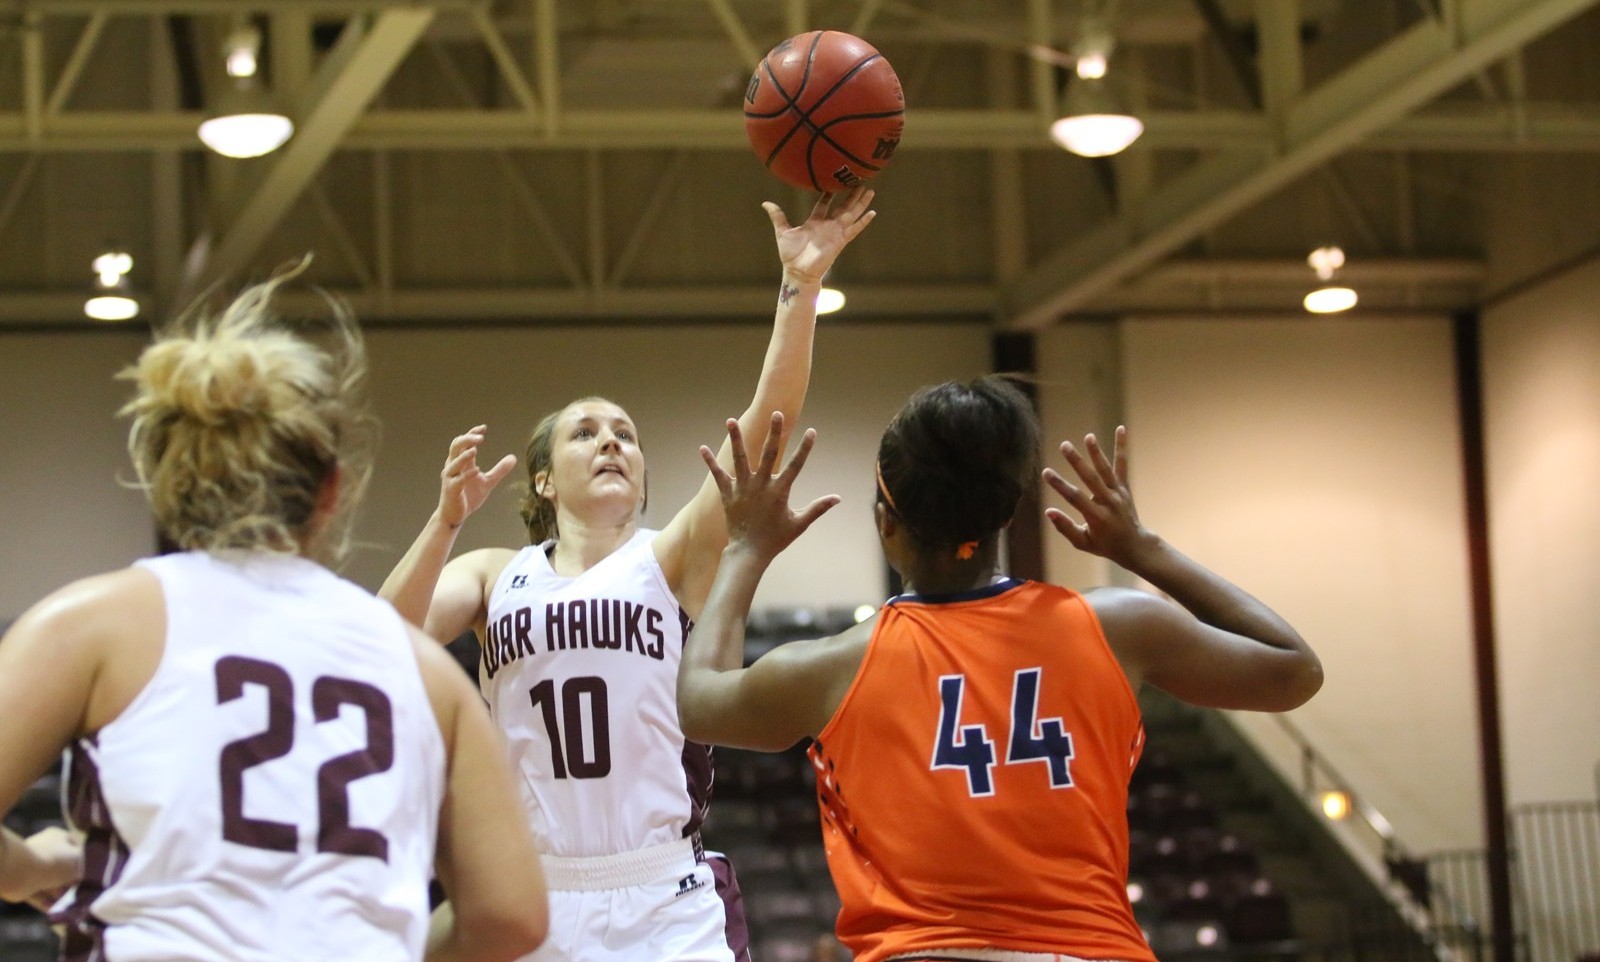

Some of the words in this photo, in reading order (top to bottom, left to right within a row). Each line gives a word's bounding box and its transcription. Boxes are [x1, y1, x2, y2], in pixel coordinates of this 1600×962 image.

[483, 607, 535, 679] WAR
[545, 599, 665, 661] HAWKS
[214, 655, 394, 865] 22
[529, 676, 612, 780] 10
[929, 667, 1075, 798] 44
